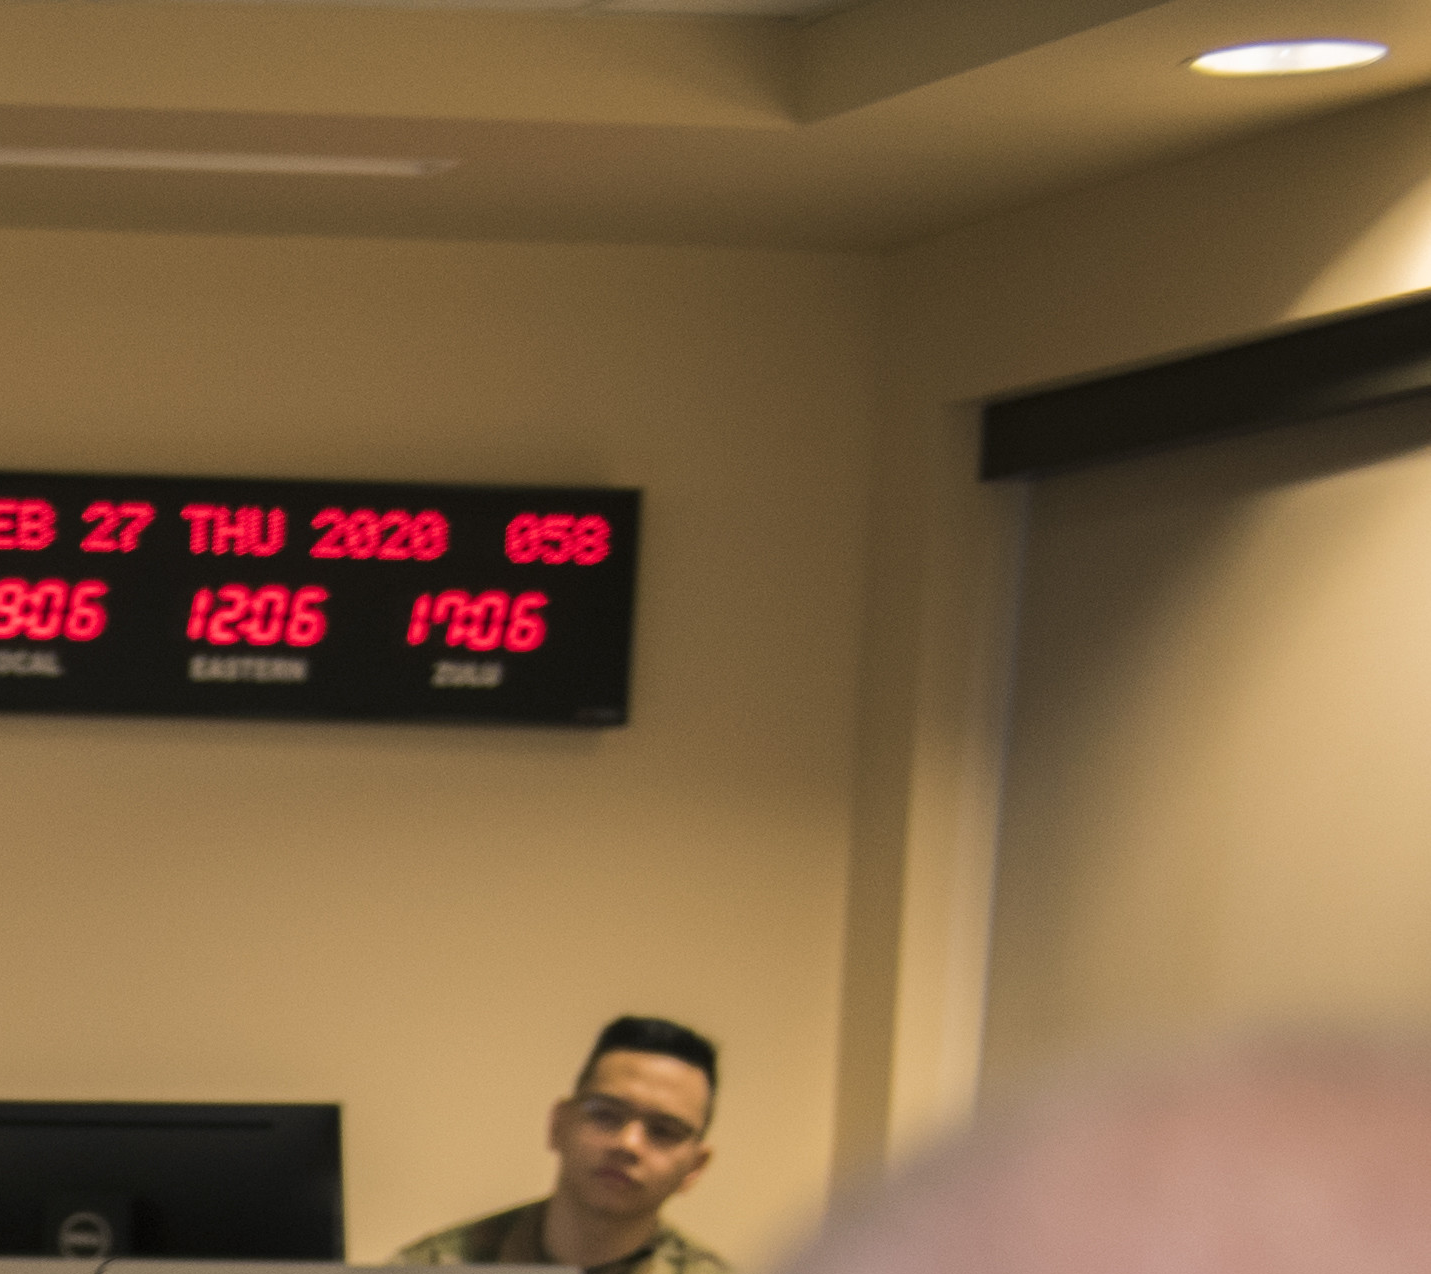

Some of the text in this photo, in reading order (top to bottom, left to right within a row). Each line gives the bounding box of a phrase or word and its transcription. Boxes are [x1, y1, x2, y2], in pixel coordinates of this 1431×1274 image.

[79, 500, 156, 553] 27
[179, 503, 288, 558] THU
[309, 506, 452, 561] 2020
[505, 512, 612, 566] 058
[188, 655, 309, 683] EASTERN
[431, 660, 505, 689] ZULU
